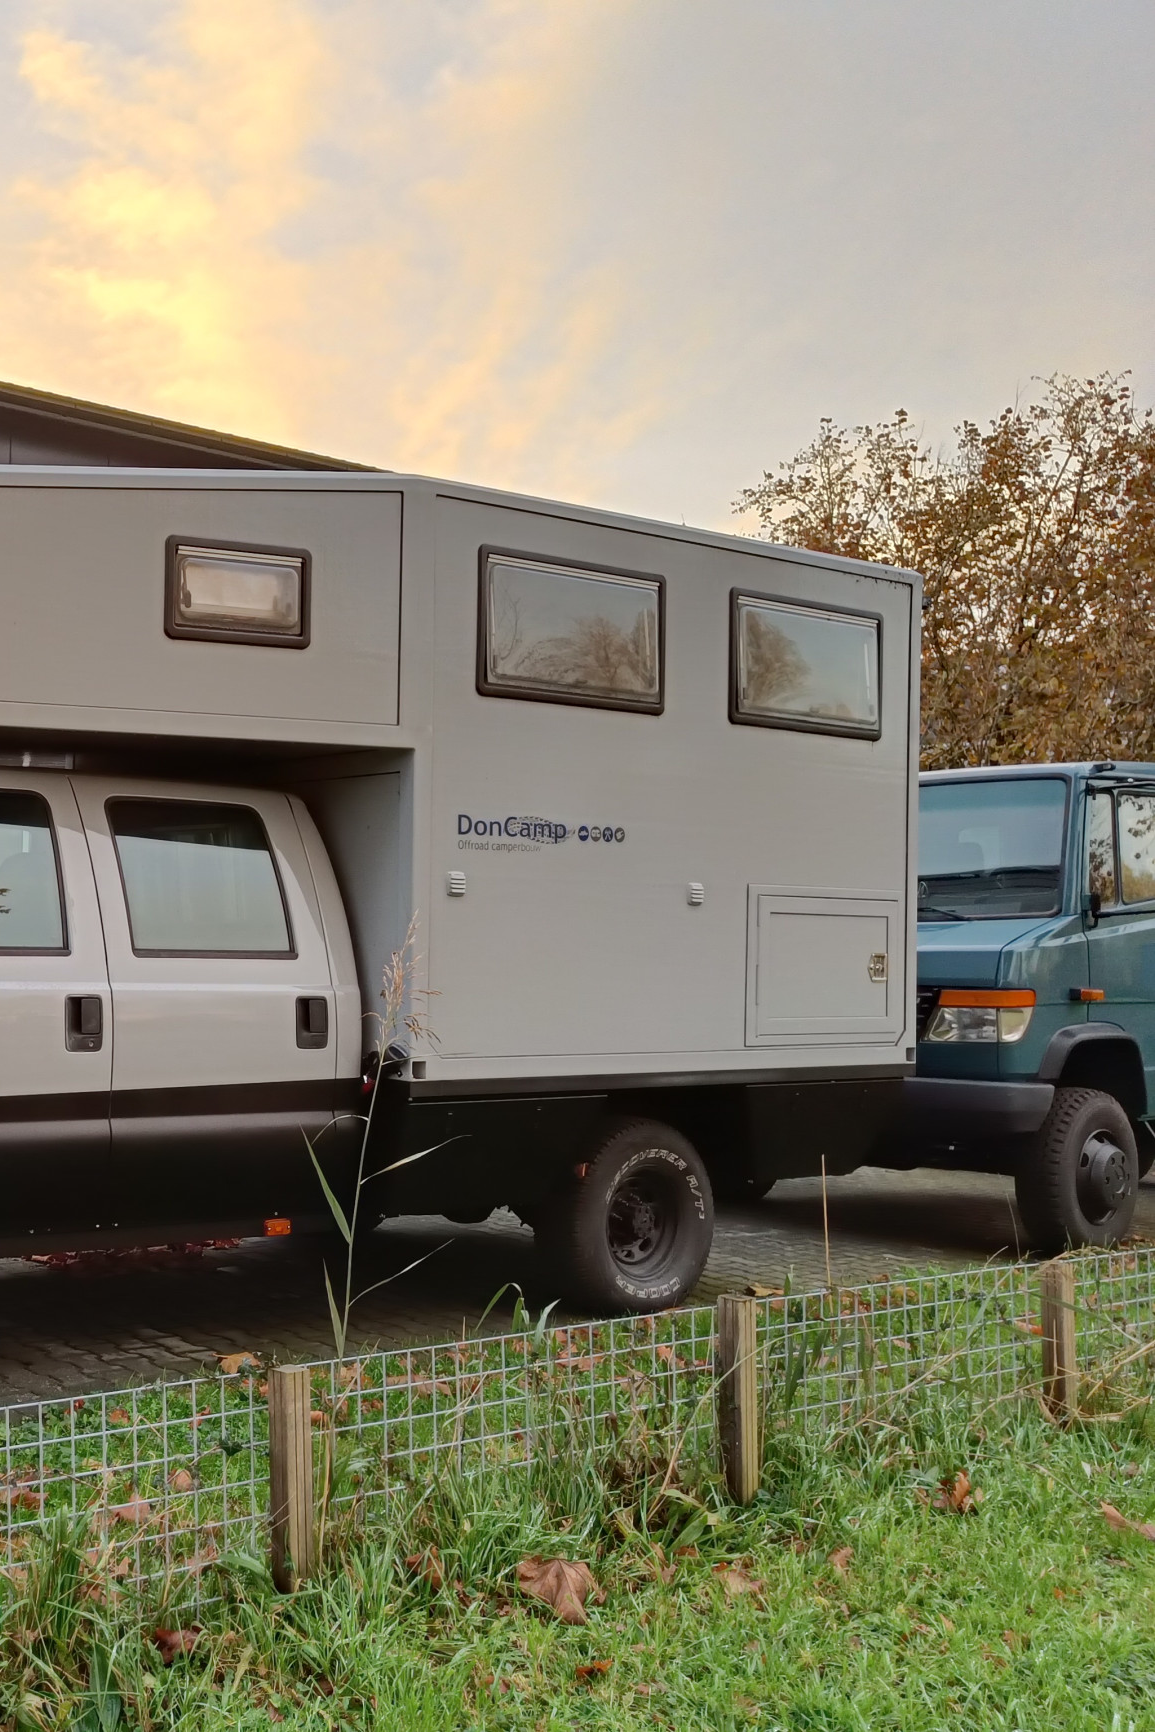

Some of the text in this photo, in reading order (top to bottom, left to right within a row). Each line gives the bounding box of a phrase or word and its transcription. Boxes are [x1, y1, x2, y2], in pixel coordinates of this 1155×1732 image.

[457, 814, 567, 844] DonCamp
[457, 839, 489, 851] Offroad
[615, 1275, 681, 1299] COOPER
